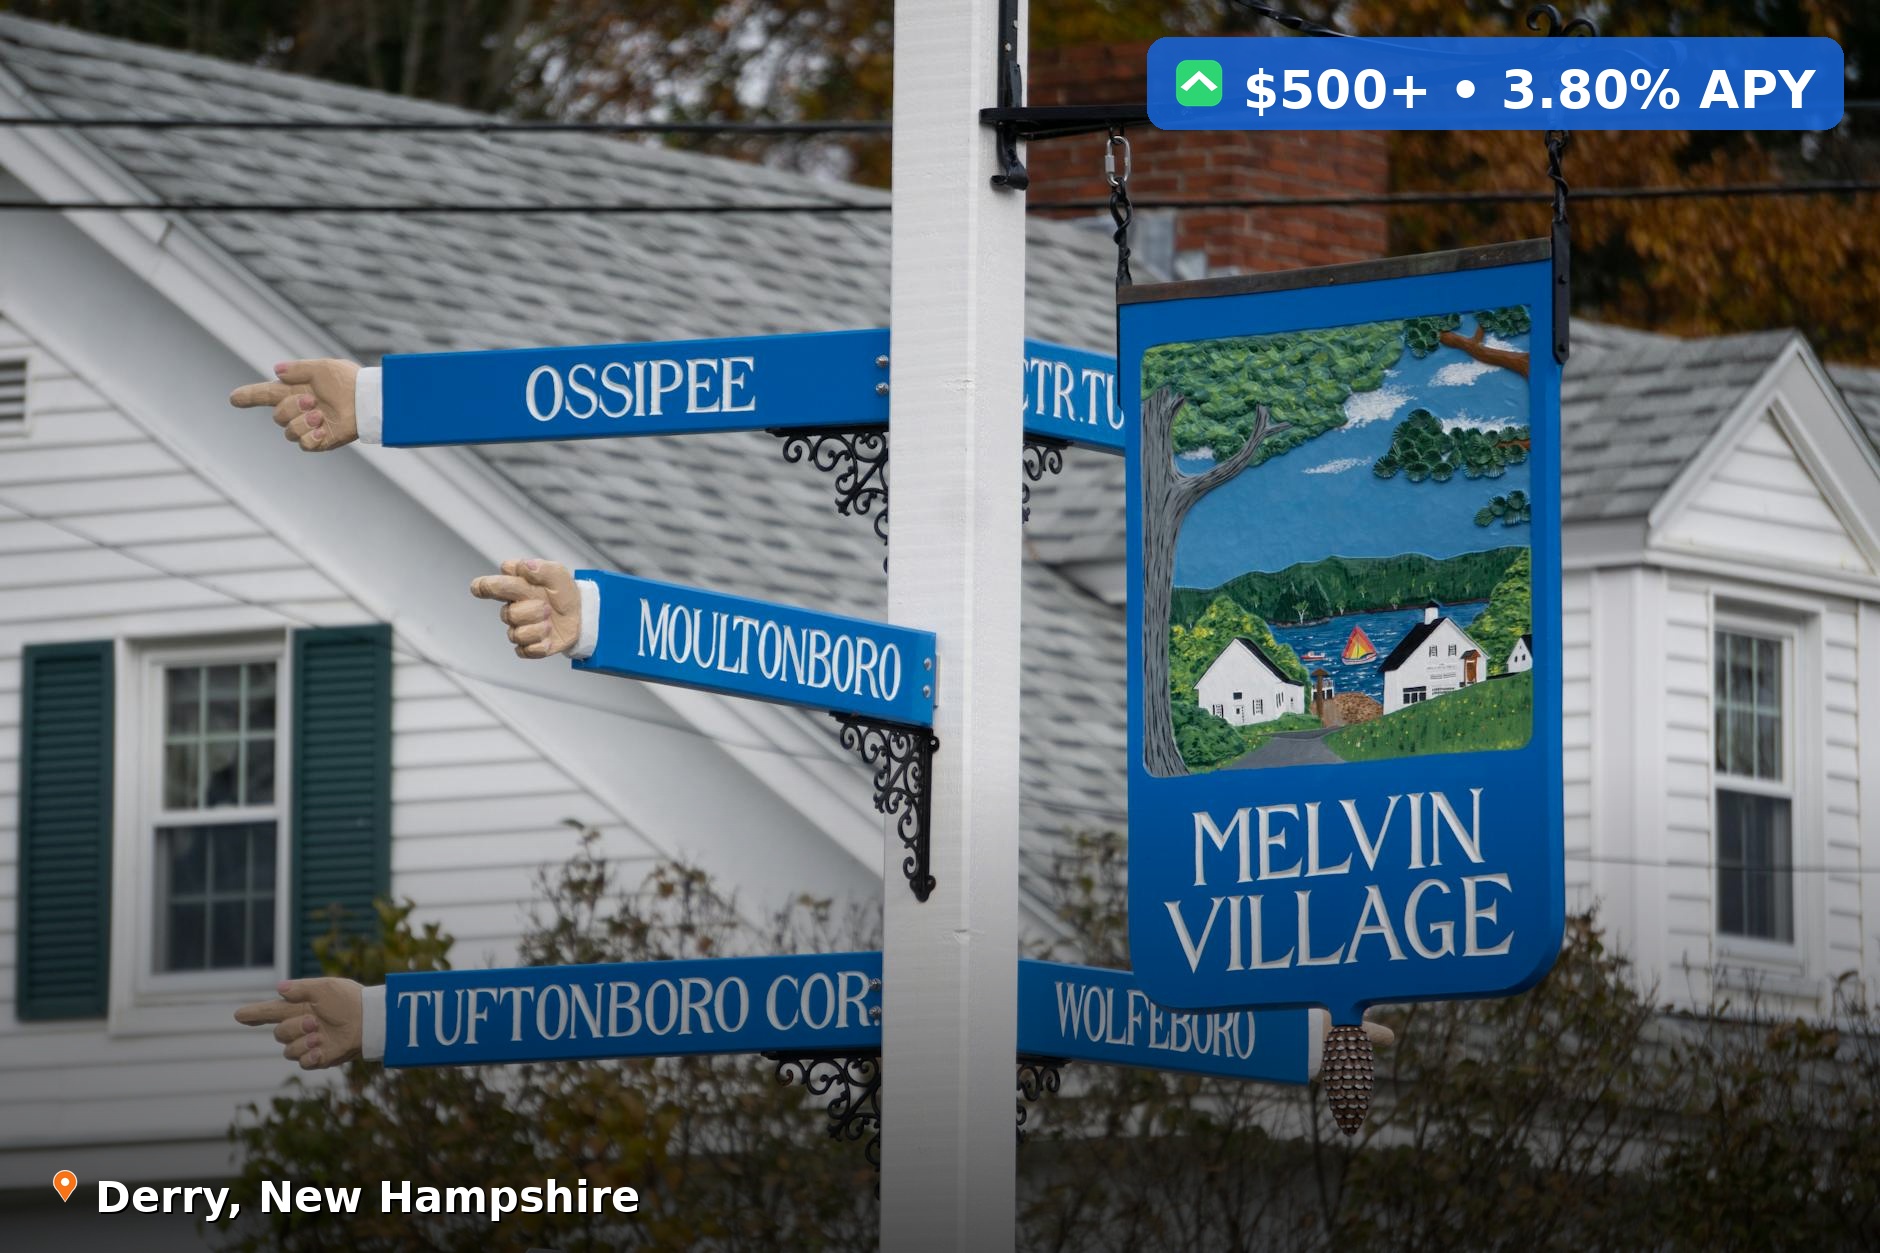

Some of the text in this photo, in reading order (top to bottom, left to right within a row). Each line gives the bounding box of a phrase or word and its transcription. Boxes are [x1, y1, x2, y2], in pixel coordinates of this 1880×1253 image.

[525, 356, 756, 422] OSSIPEE
[637, 598, 901, 702] MOULTONBORO
[1192, 787, 1486, 886] MELVIN
[1163, 872, 1515, 974] VILLAGE
[397, 971, 881, 1048] TUFTONBORO COR.
[1054, 981, 1256, 1060] WOLFEBORO
